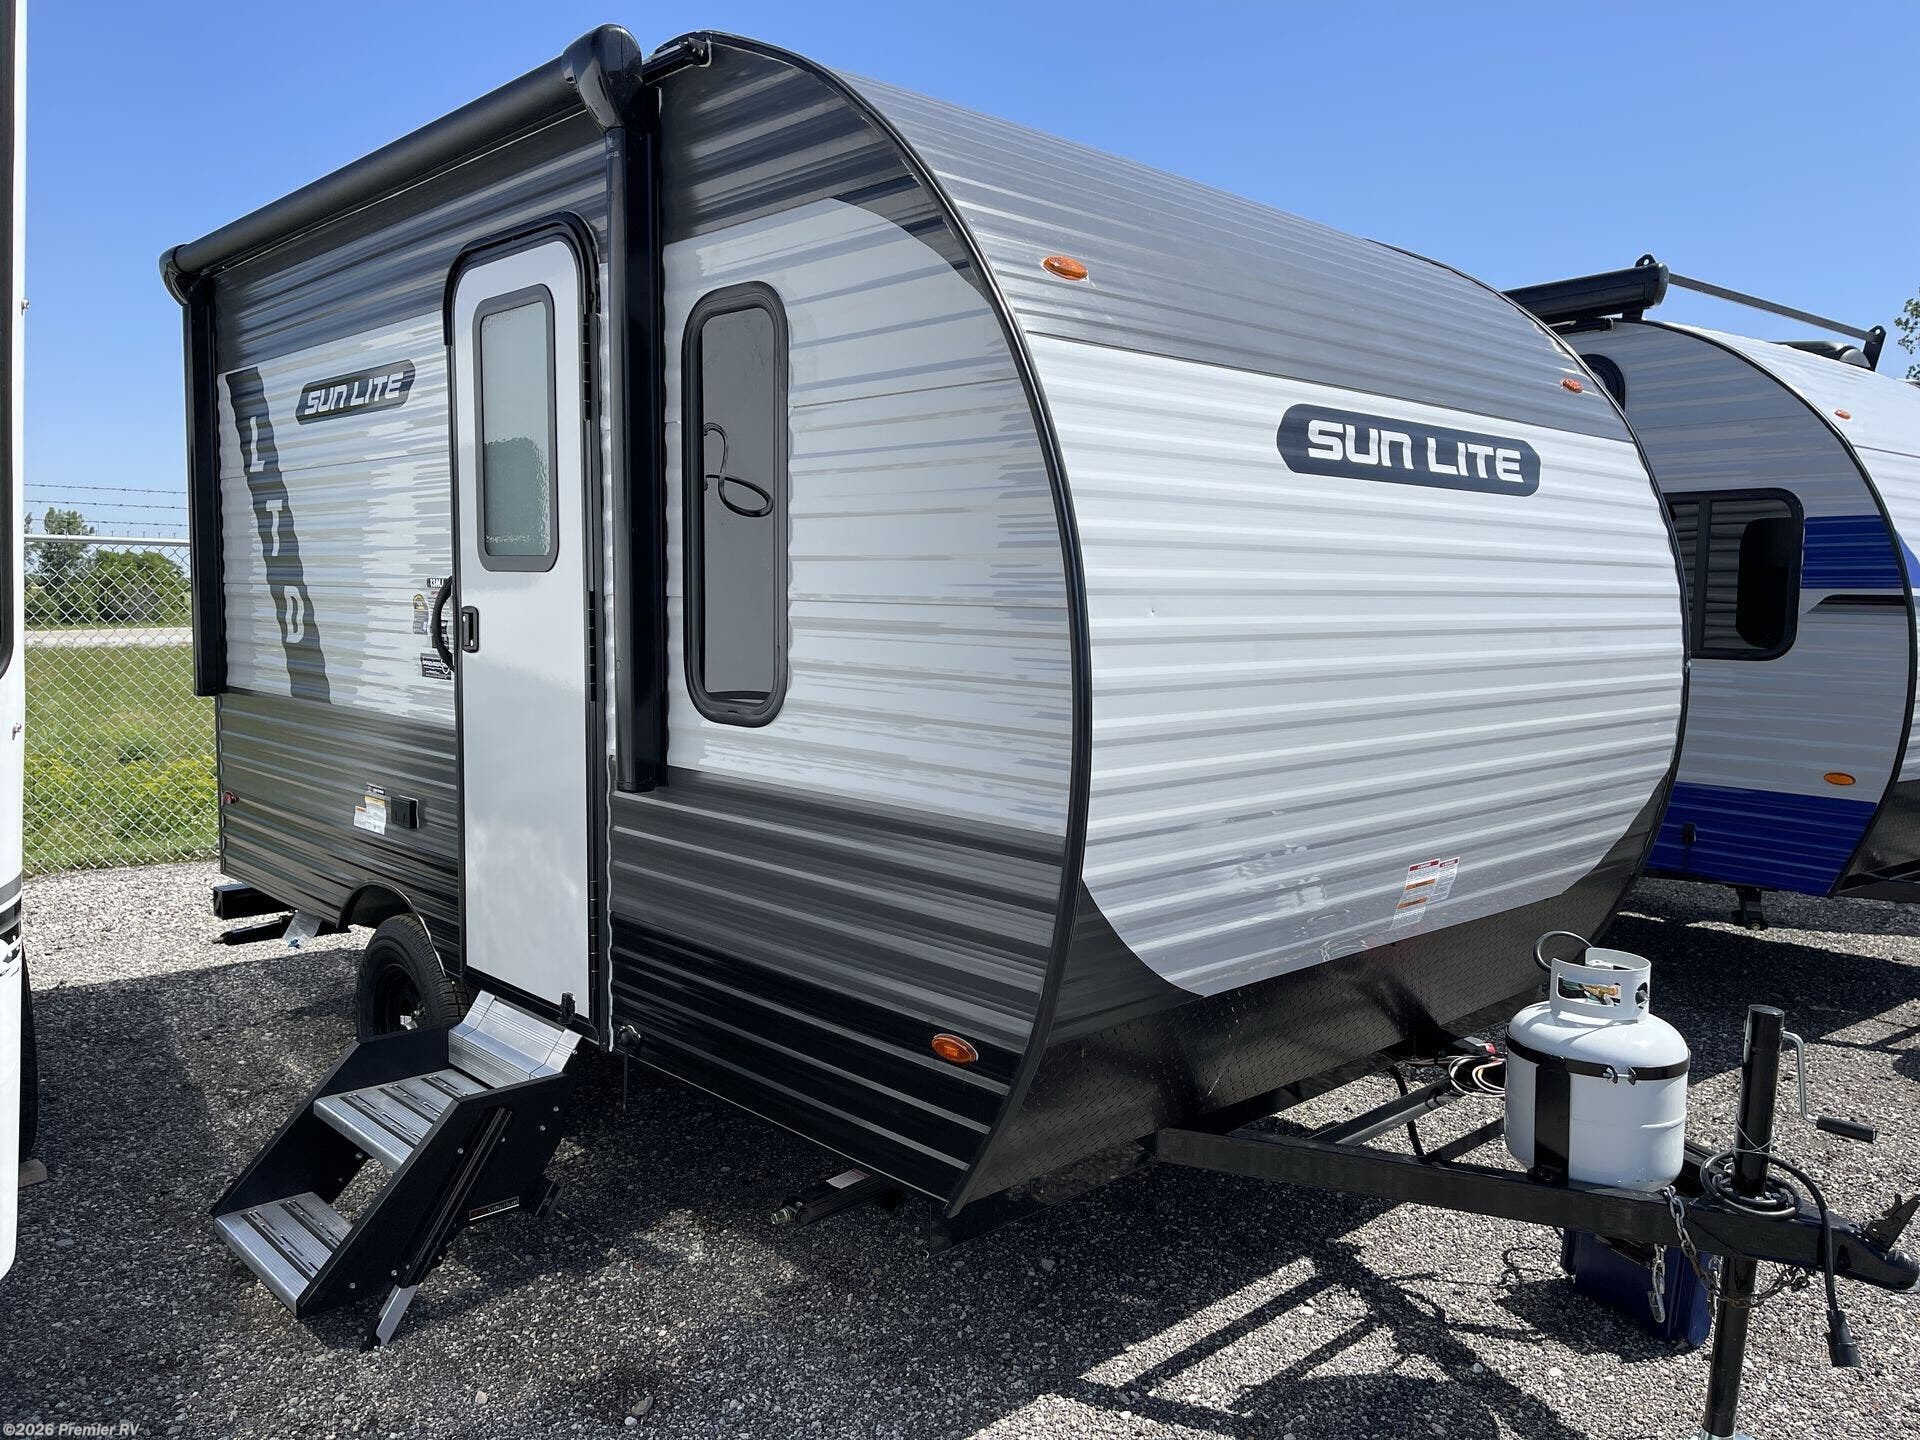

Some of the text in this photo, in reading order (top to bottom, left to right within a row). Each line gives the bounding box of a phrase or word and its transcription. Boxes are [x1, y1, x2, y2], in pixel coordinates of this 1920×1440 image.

[304, 371, 404, 415] SUN LITE
[1308, 419, 1524, 483] SUN LITE
